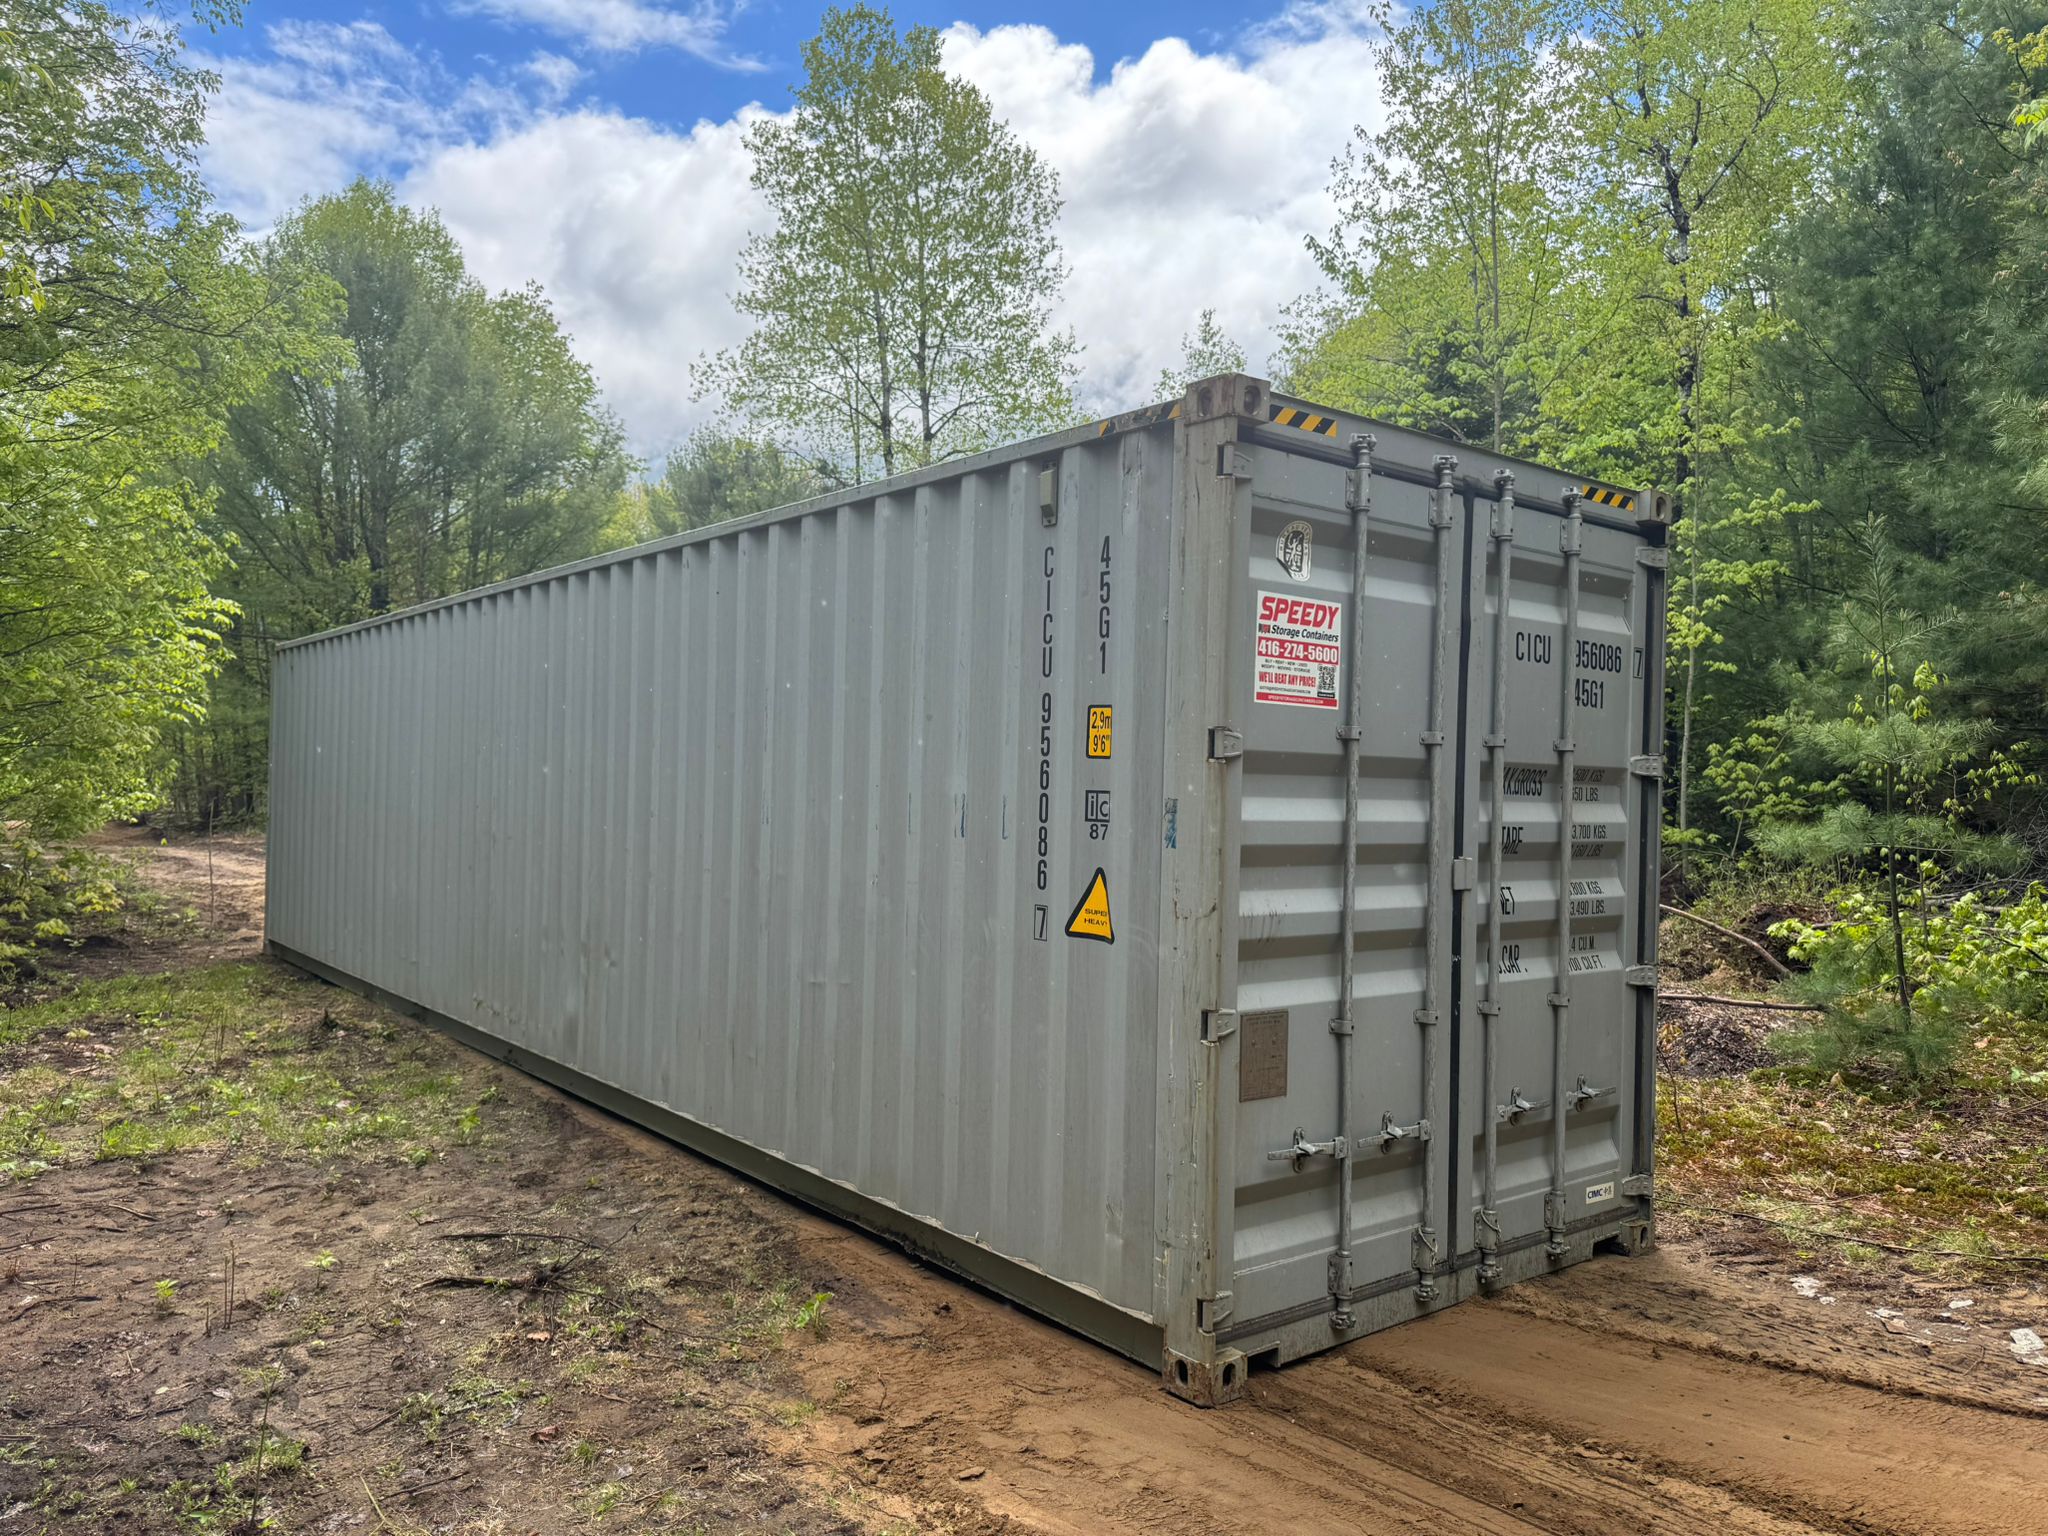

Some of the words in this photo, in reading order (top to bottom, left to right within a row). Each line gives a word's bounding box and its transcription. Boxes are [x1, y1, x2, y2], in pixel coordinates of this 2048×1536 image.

[1042, 546, 1054, 678] CICU
[1099, 535, 1111, 675] 45G1
[1259, 595, 1340, 630] SPEEDY
[1271, 624, 1300, 639] Storage
[1301, 628, 1340, 643] Containers
[1258, 639, 1338, 663] 416-274-5600
[1515, 631, 1551, 665] CICU
[1634, 648, 1643, 678] 7
[1034, 692, 1051, 891] 956086
[1090, 823, 1109, 841] 87
[1034, 906, 1048, 939] 7
[1588, 1188, 1603, 1199] CIMC
